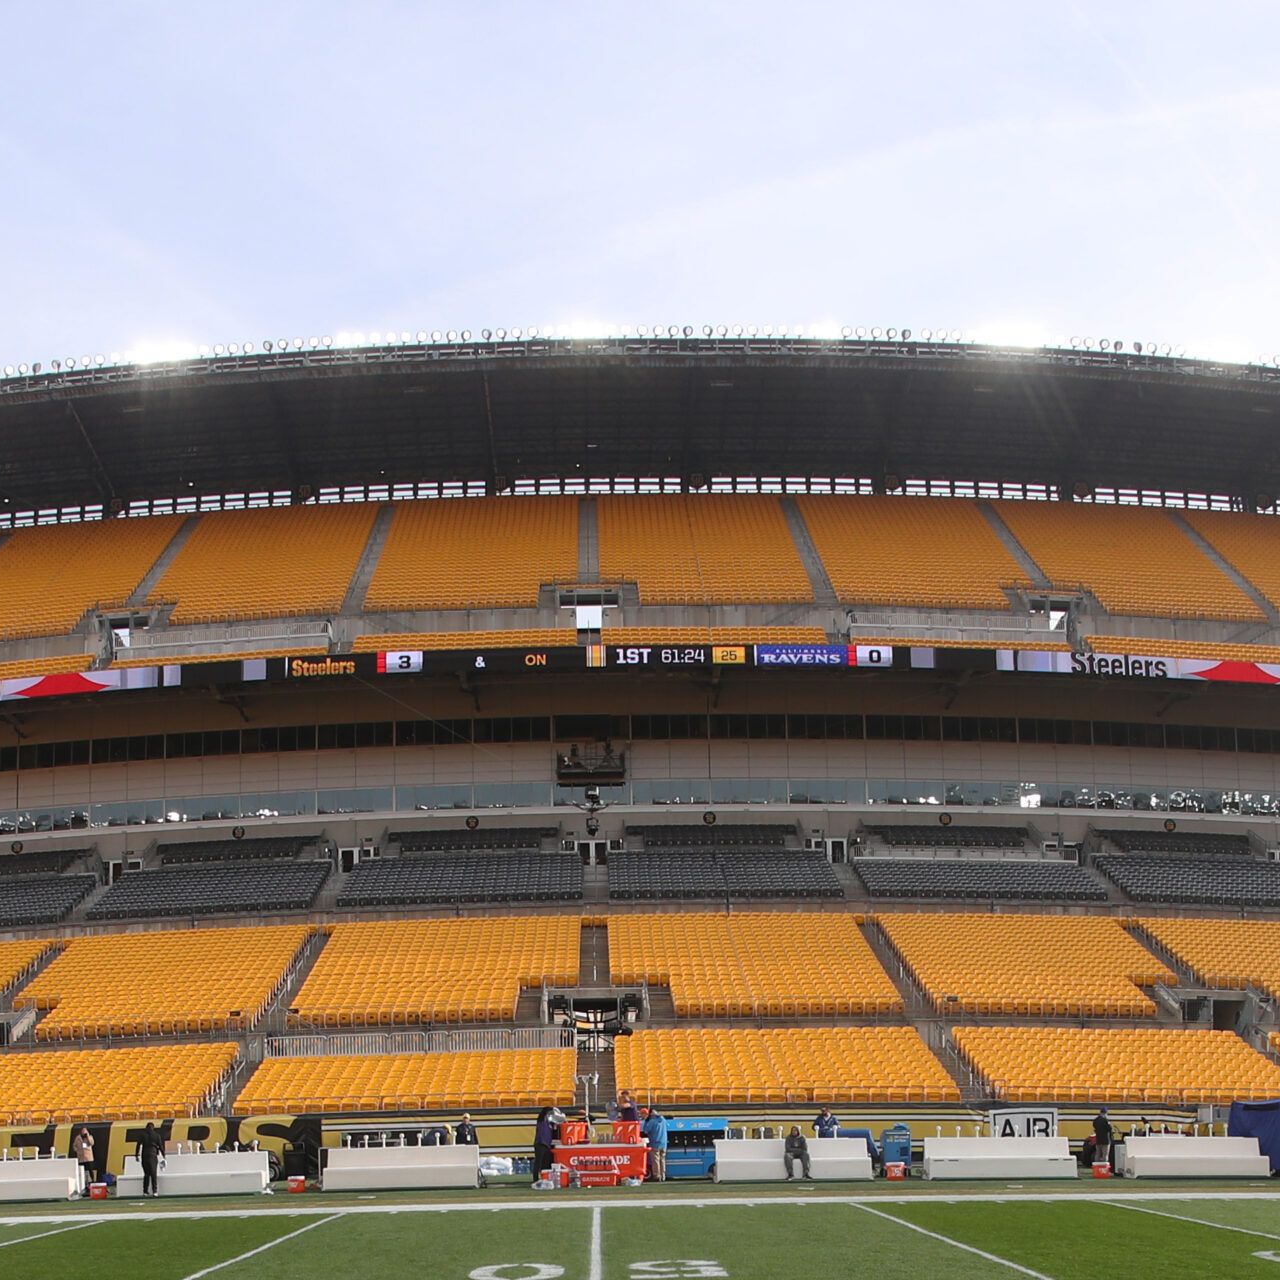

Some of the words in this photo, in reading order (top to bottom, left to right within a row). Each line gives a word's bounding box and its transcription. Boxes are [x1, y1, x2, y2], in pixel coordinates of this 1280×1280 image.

[474, 656, 486, 668] &
[525, 654, 546, 666] ON
[616, 648, 652, 664] 1ST
[661, 649, 705, 663] 61:24
[720, 650, 738, 661] 25
[760, 654, 841, 664] RAVENS
[869, 650, 881, 663] 0
[291, 658, 356, 677] Steelers
[398, 655, 411, 669] 3
[1070, 651, 1167, 679] Steelers
